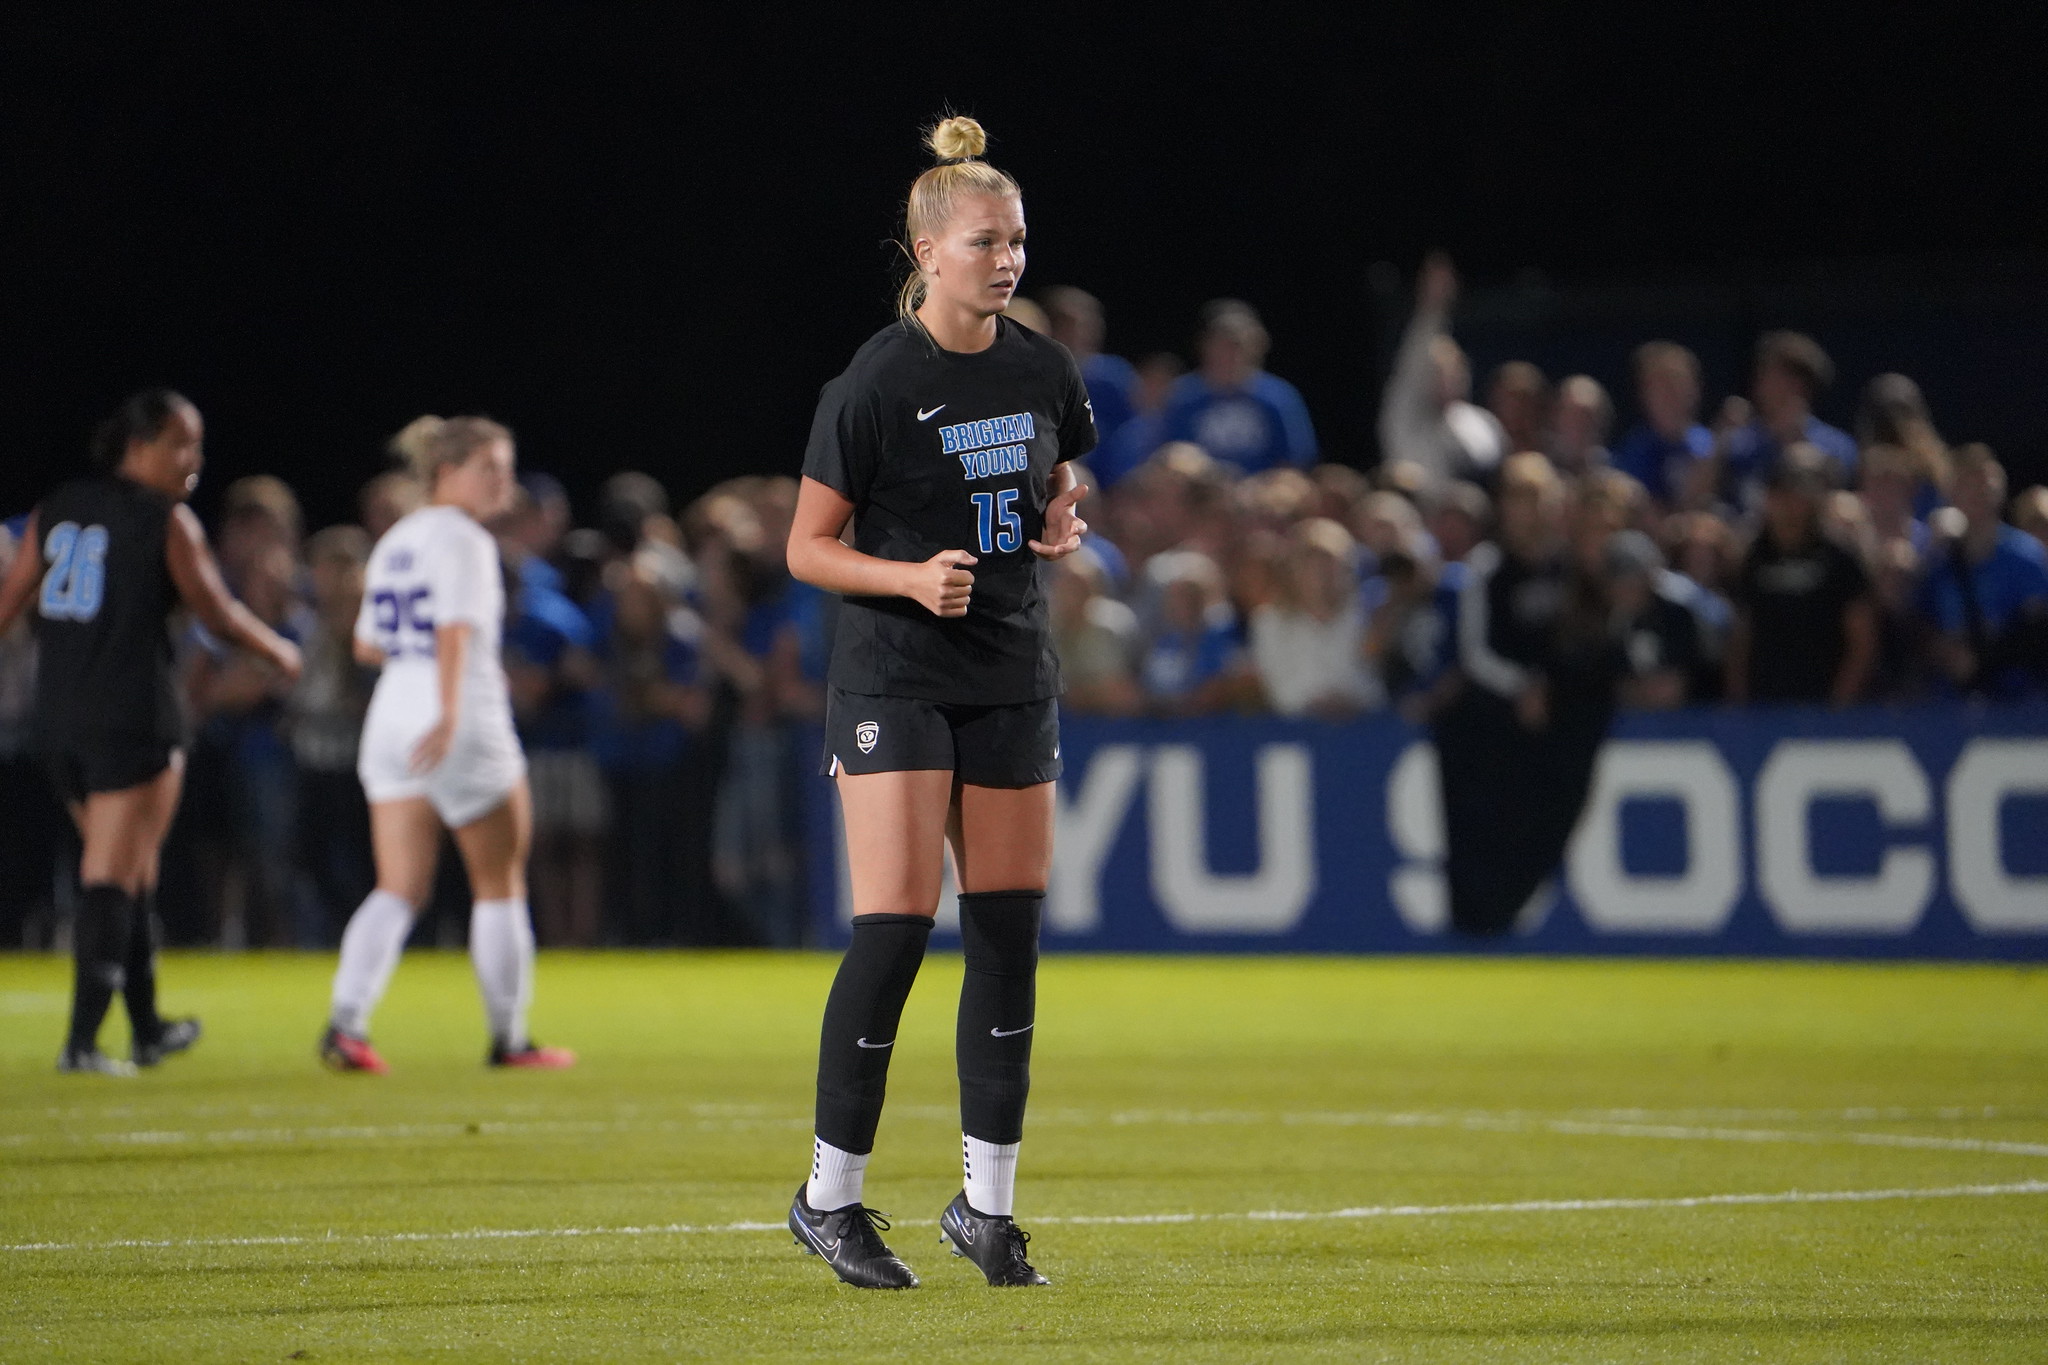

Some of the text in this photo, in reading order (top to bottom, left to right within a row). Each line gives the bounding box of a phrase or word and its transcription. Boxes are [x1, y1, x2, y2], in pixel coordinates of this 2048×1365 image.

[939, 412, 1035, 454] BRIGHAM
[959, 444, 1028, 480] YOUNG
[971, 488, 1023, 553] 15
[39, 520, 109, 622] 26
[834, 743, 1318, 933] YU
